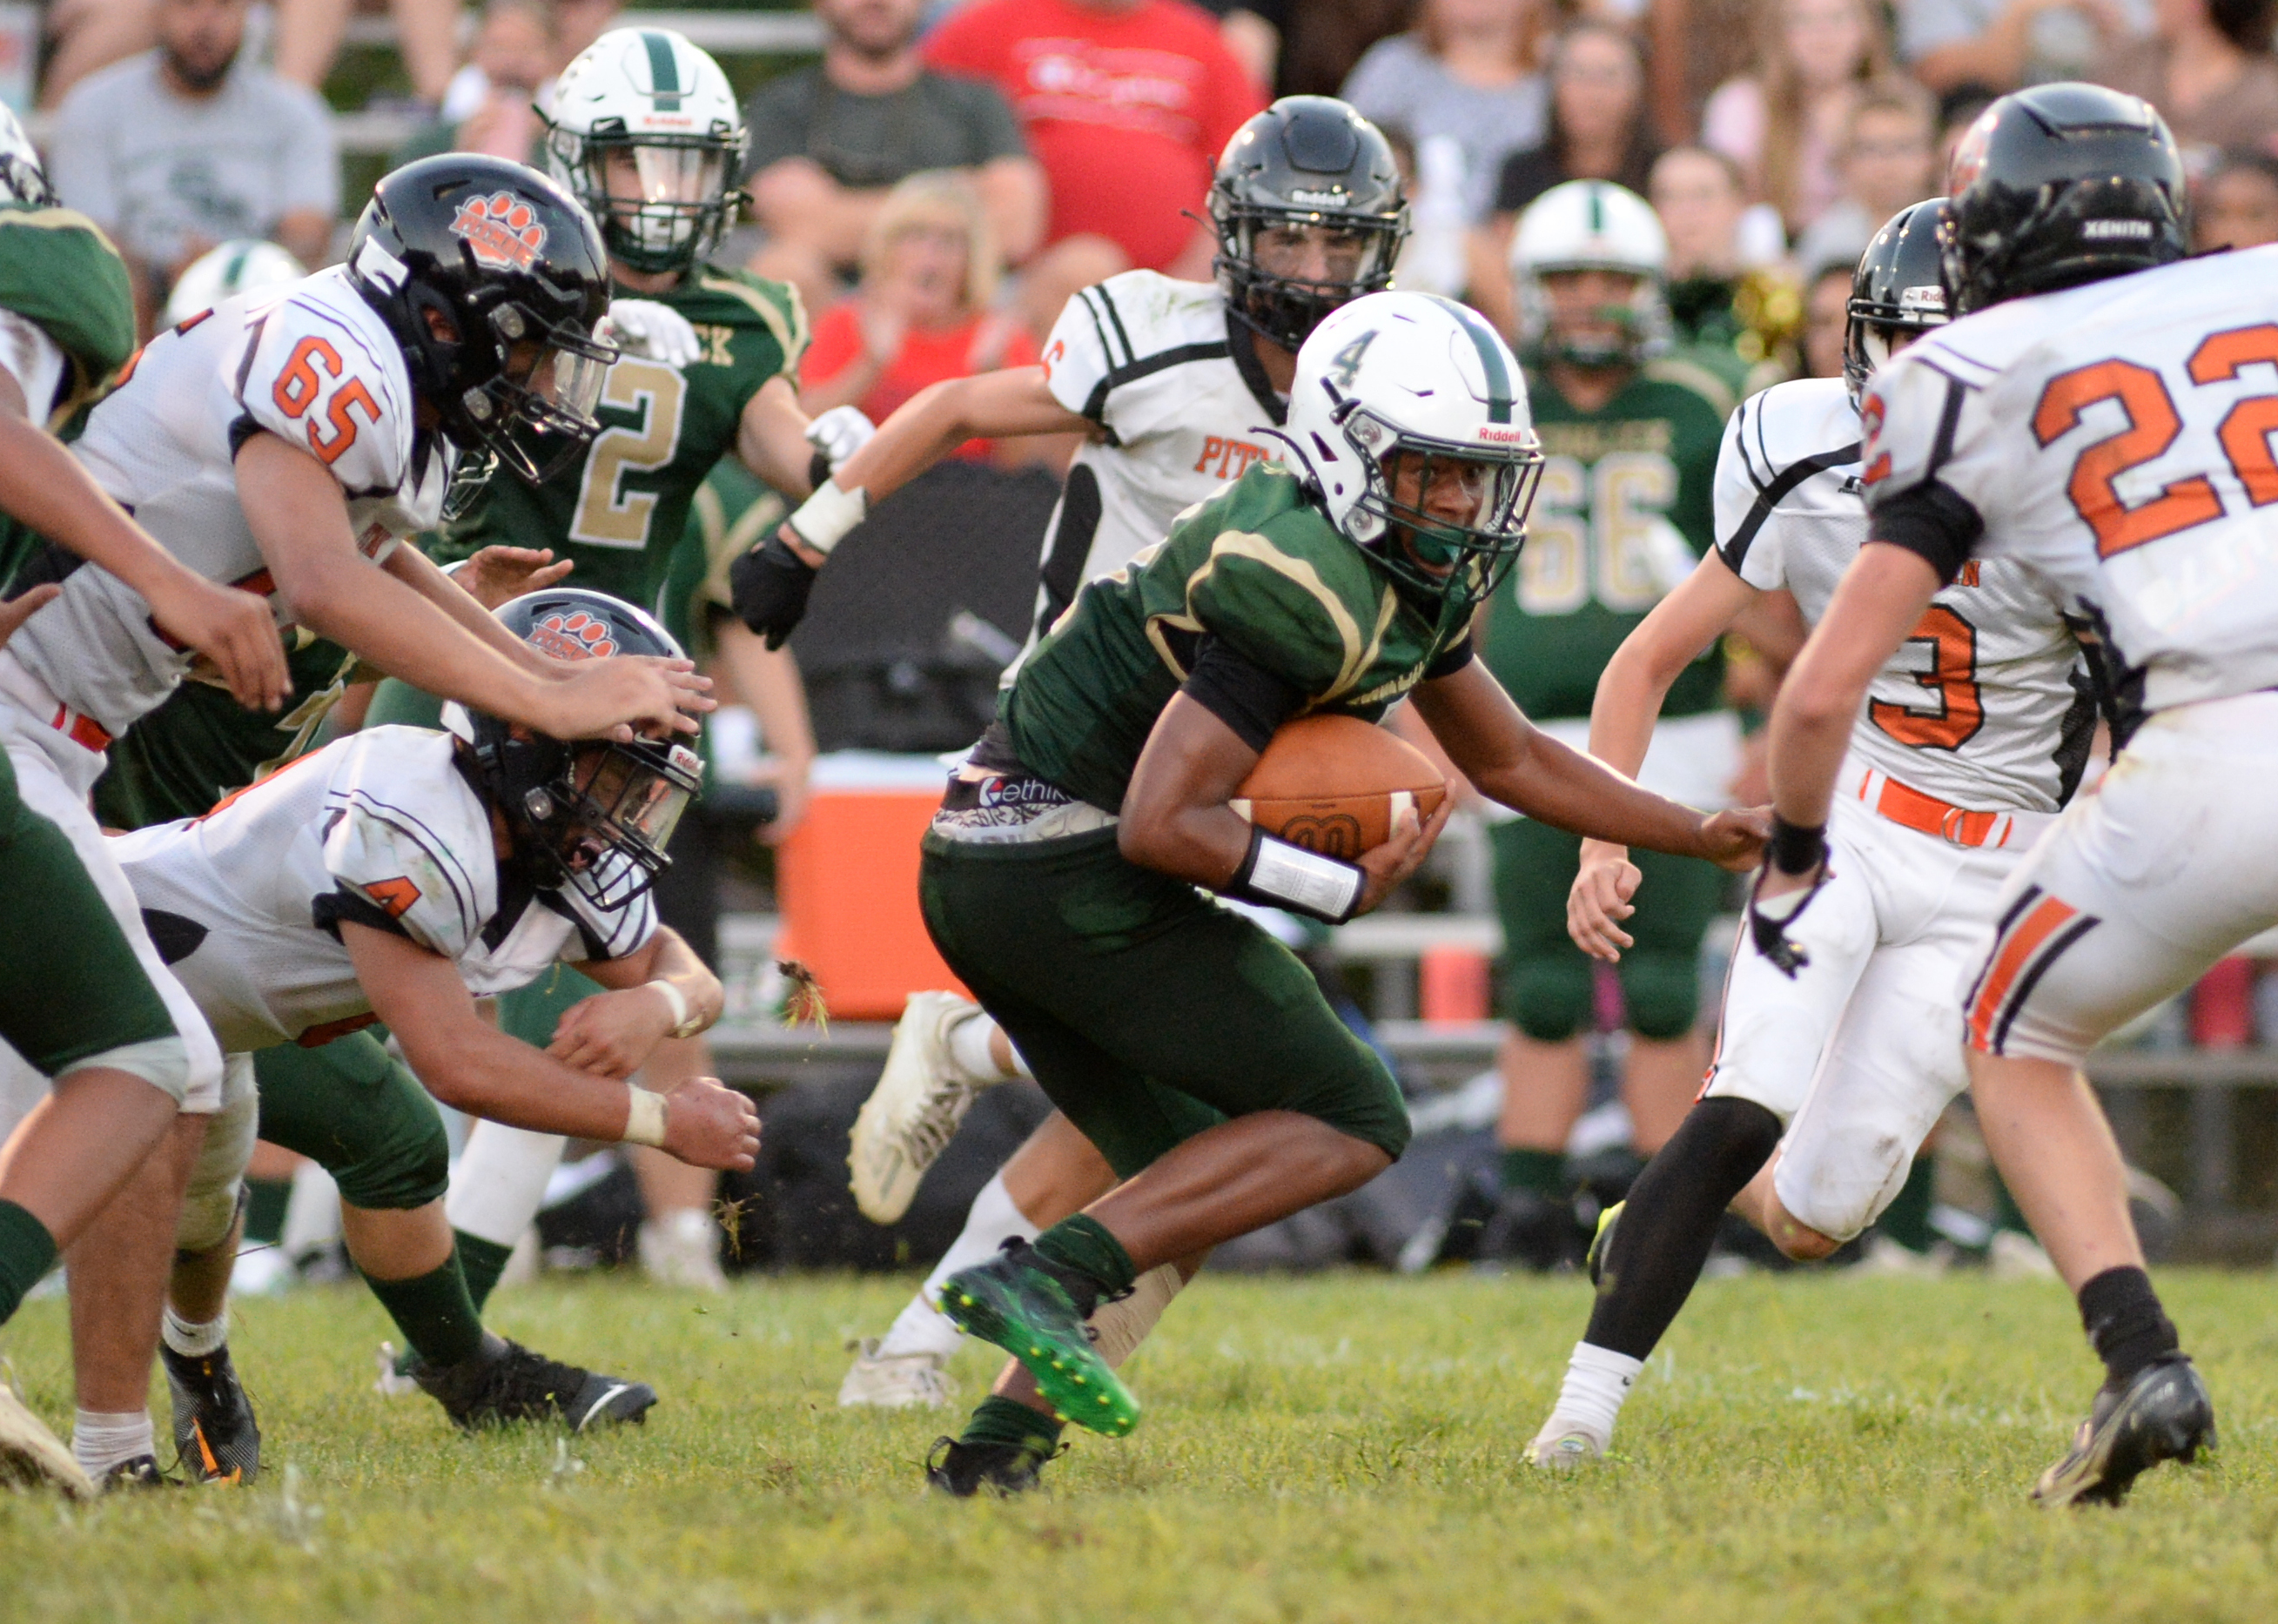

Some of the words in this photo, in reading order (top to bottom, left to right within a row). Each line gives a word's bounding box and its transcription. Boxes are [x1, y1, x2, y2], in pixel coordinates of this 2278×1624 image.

[2084, 219, 2154, 238] XENITH
[272, 333, 382, 466] 65
[1331, 329, 1380, 391] 4
[568, 352, 689, 550] 2
[1478, 426, 1522, 442] Riddell
[1869, 601, 1986, 752] 3
